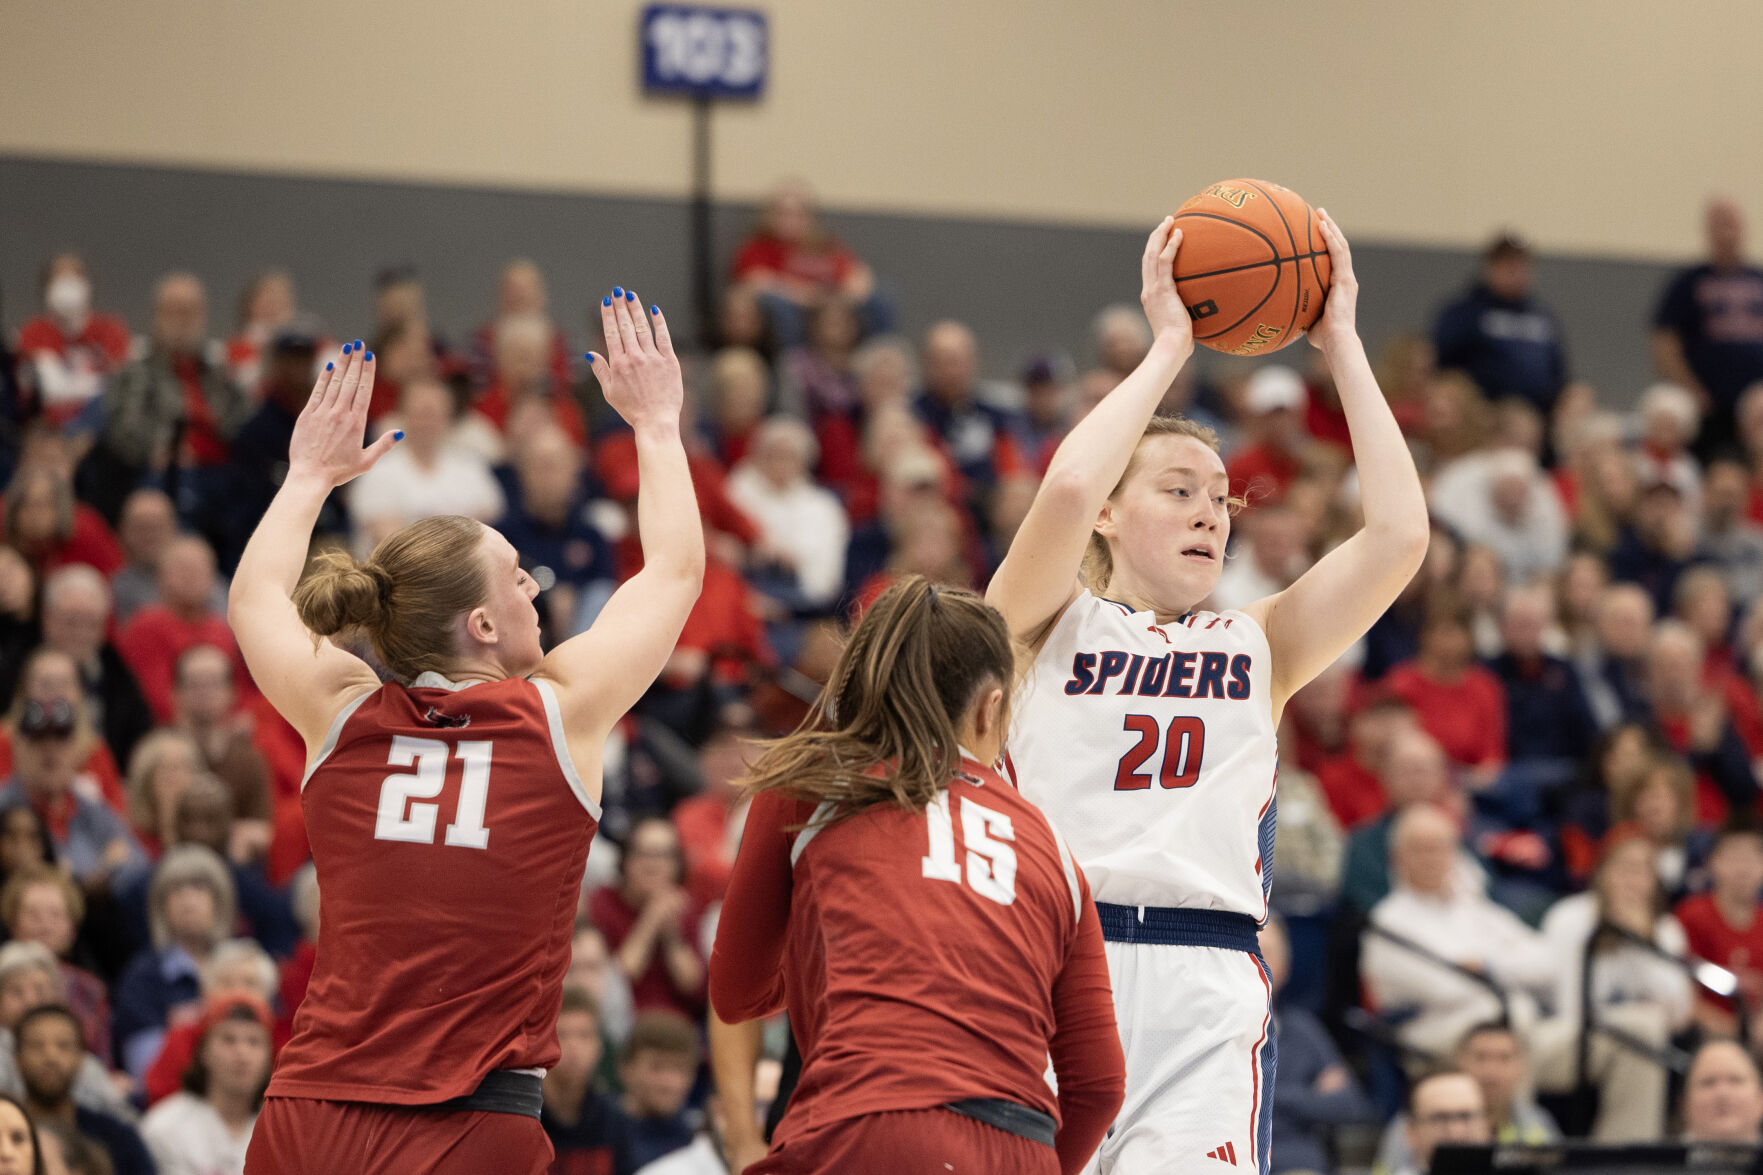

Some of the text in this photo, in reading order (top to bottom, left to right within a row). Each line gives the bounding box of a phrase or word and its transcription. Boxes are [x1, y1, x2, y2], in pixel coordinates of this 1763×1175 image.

[651, 15, 761, 86] 103
[1064, 651, 1252, 700] SPIDERS
[1114, 714, 1206, 791] 20
[374, 735, 493, 850] 21
[922, 790, 1018, 906] 15
